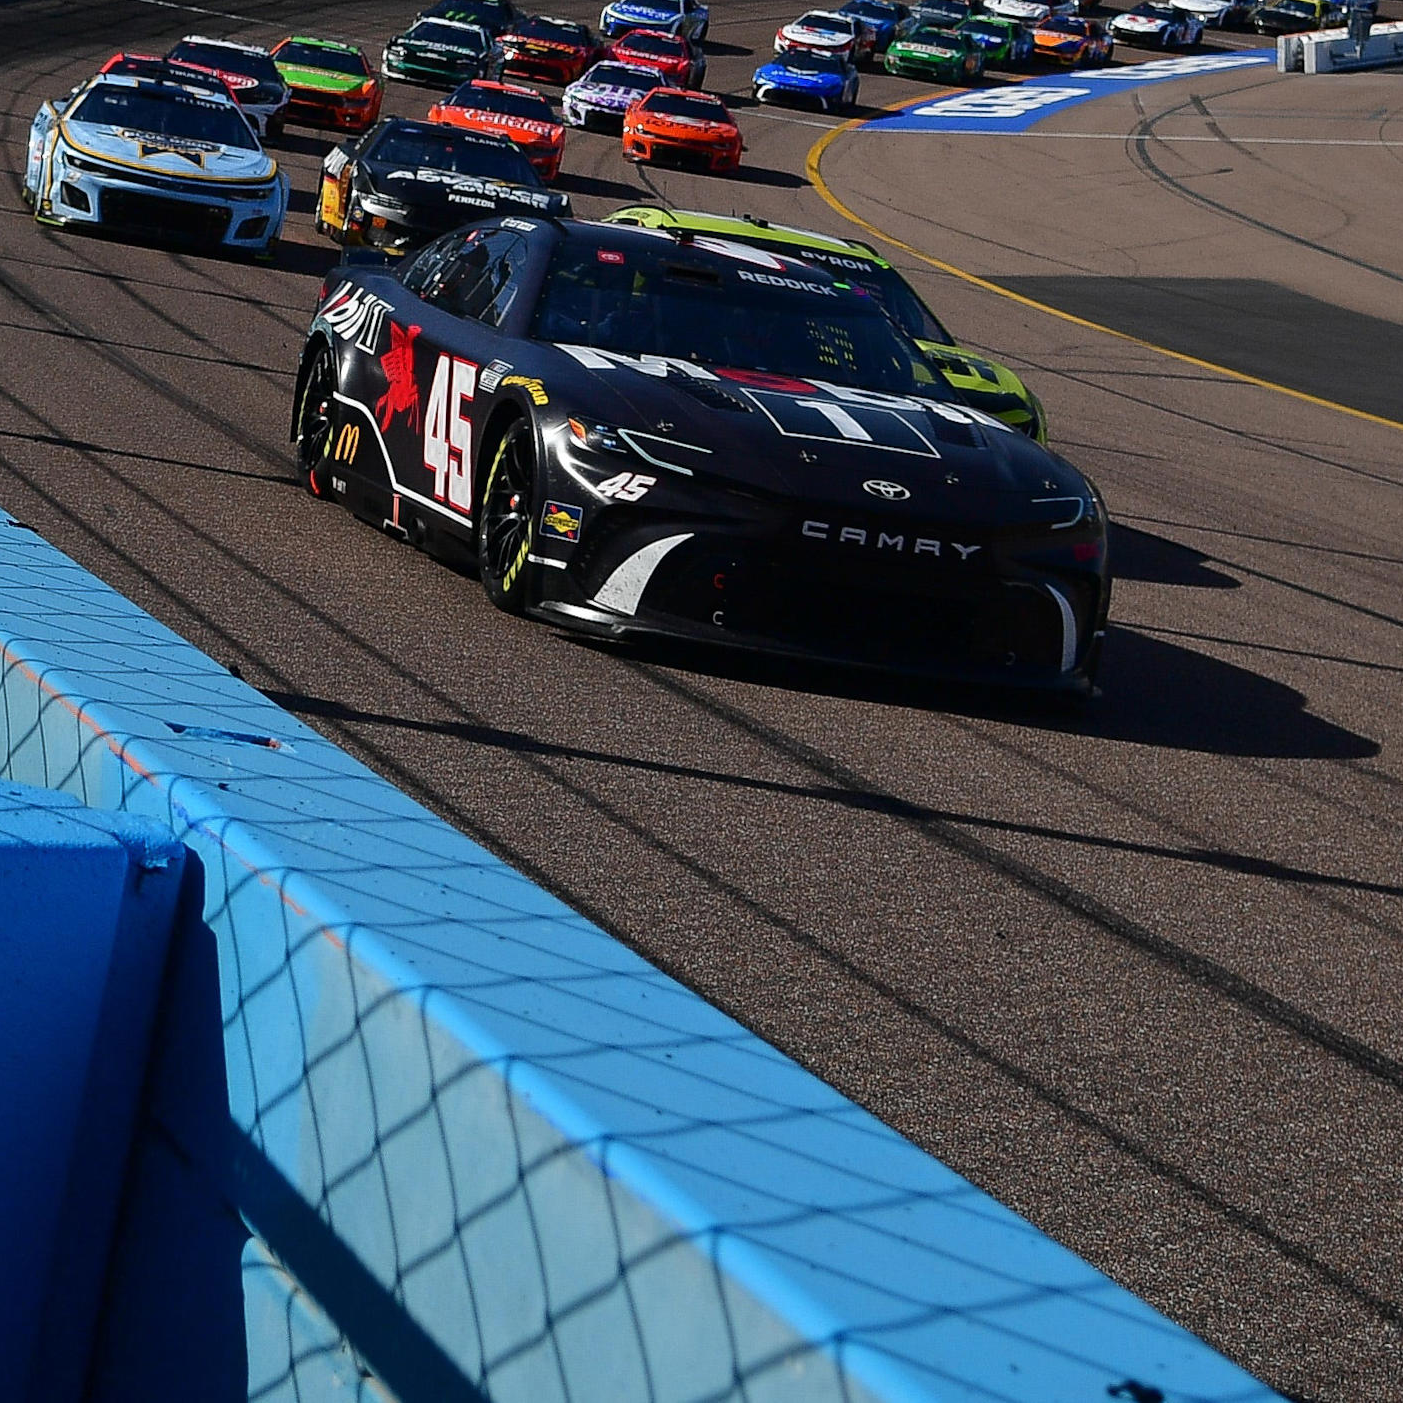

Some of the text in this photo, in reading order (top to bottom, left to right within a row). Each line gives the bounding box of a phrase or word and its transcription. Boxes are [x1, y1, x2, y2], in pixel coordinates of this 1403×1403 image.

[800, 250, 873, 273] BYRON
[736, 269, 840, 298] REDDICK
[553, 342, 1014, 434] Mobil
[423, 351, 479, 515] 45
[595, 470, 659, 503] 45
[802, 520, 982, 560] CAMRY
